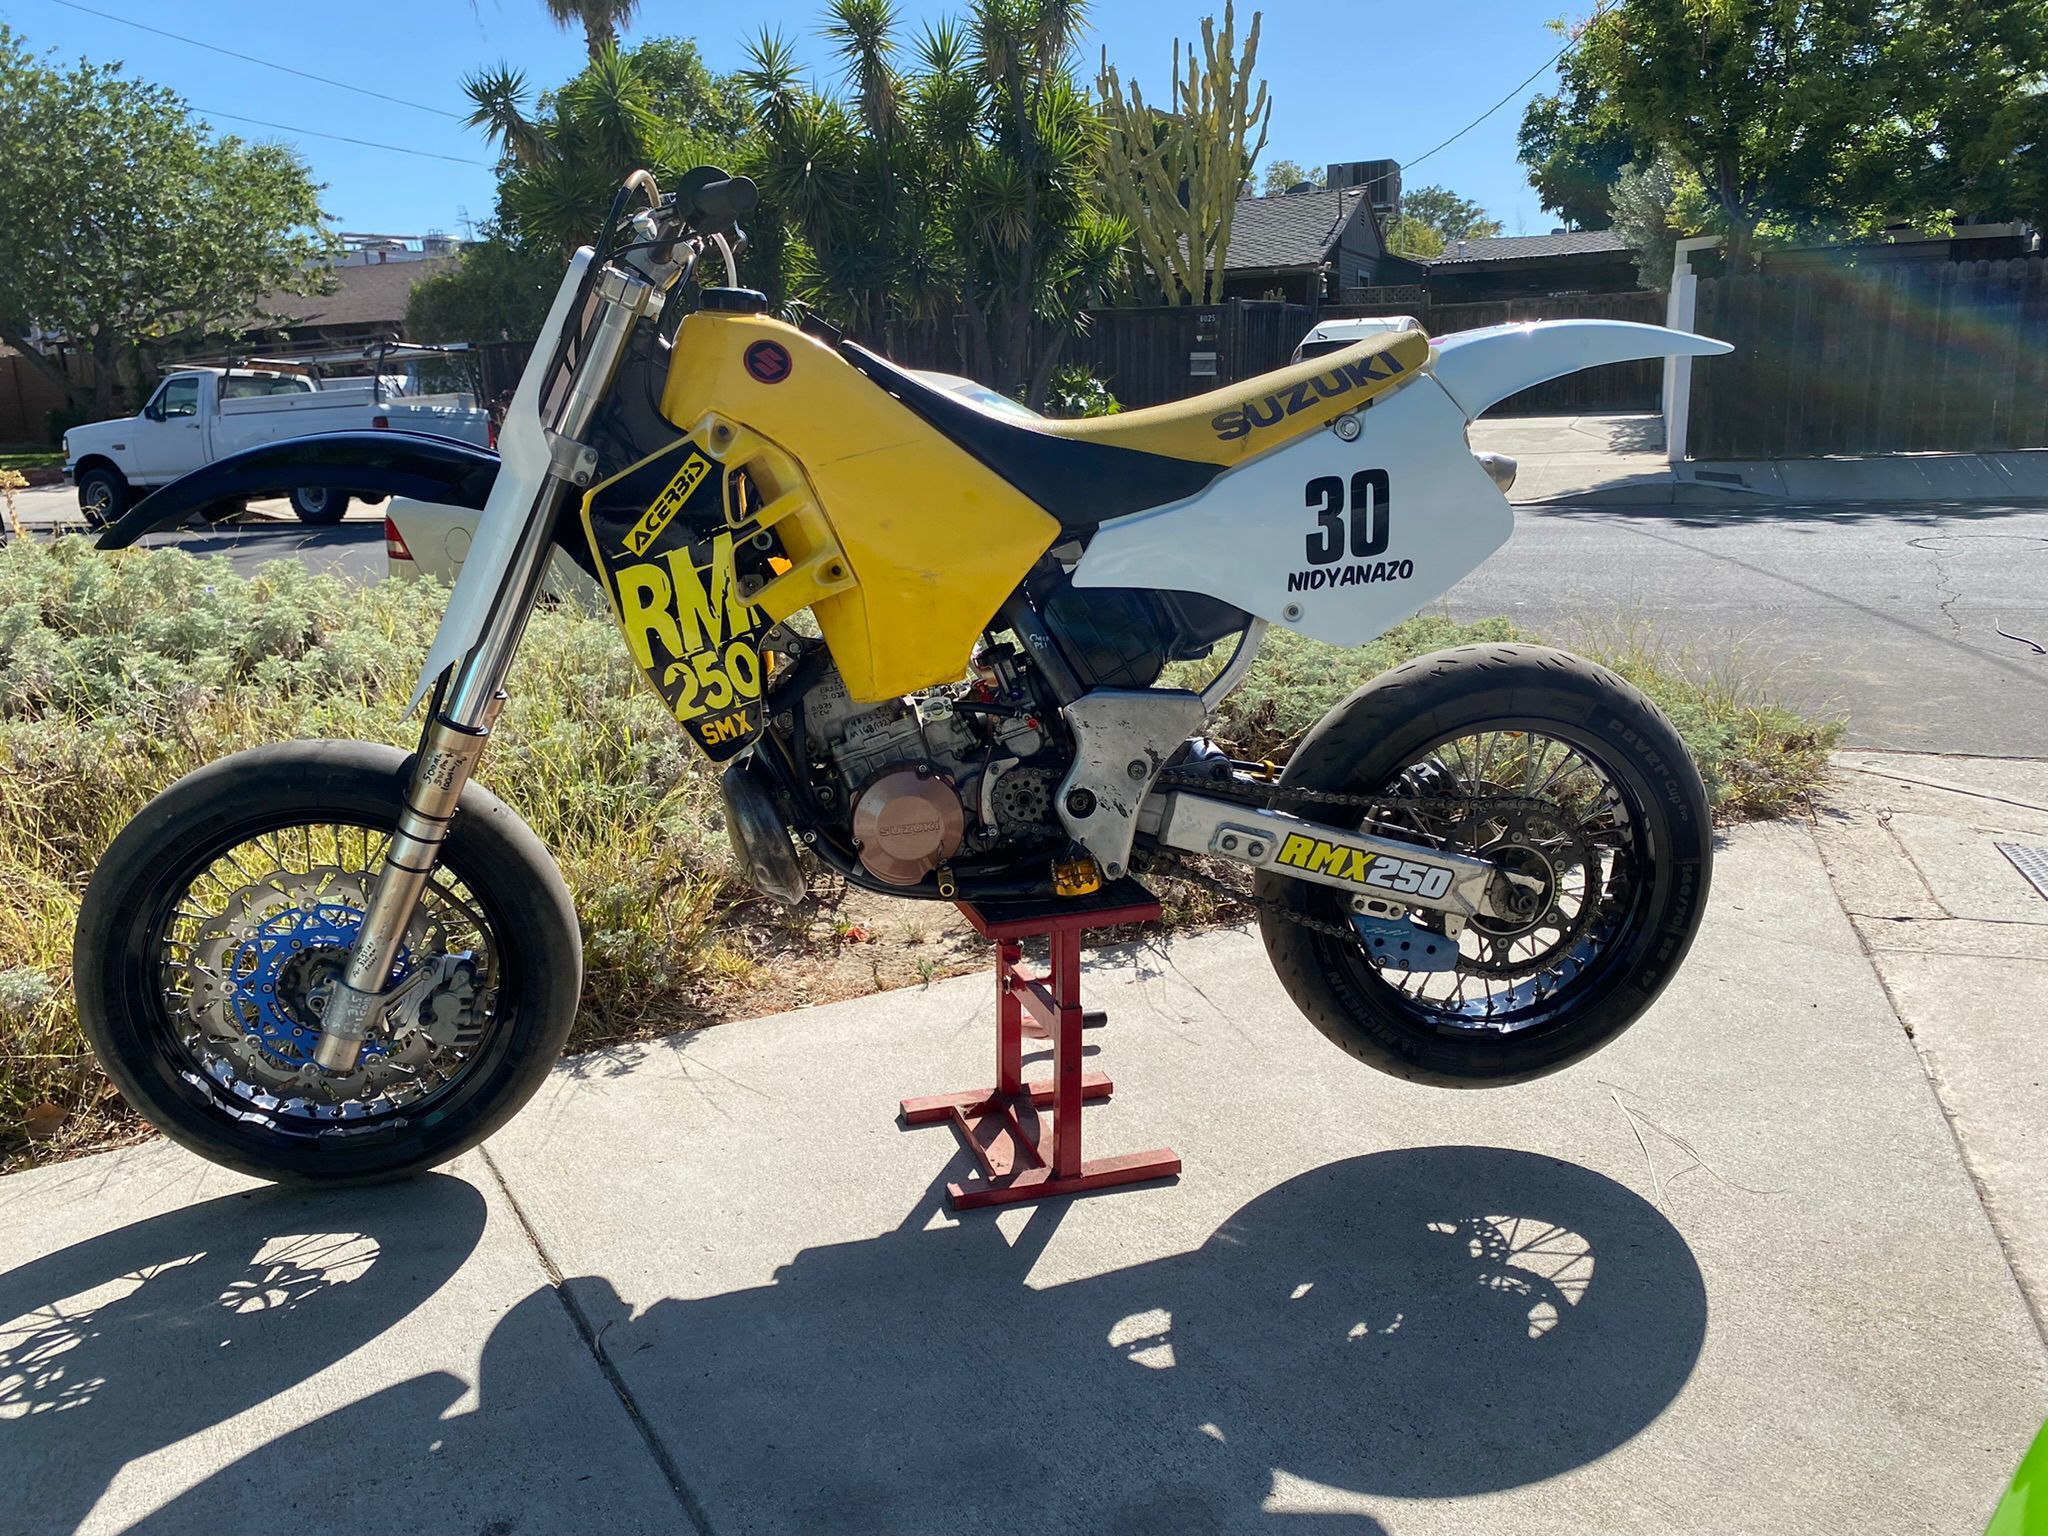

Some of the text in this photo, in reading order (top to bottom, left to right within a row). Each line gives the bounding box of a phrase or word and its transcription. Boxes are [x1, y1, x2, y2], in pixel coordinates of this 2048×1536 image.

[1211, 351, 1405, 441] SUZUKI
[1305, 468, 1390, 566] 30
[1287, 559, 1414, 592] NIDYANAZO
[663, 641, 760, 721] 250
[700, 709, 754, 745] SMX
[879, 818, 941, 838] SUZUKI
[1275, 832, 1455, 899] RMX250
